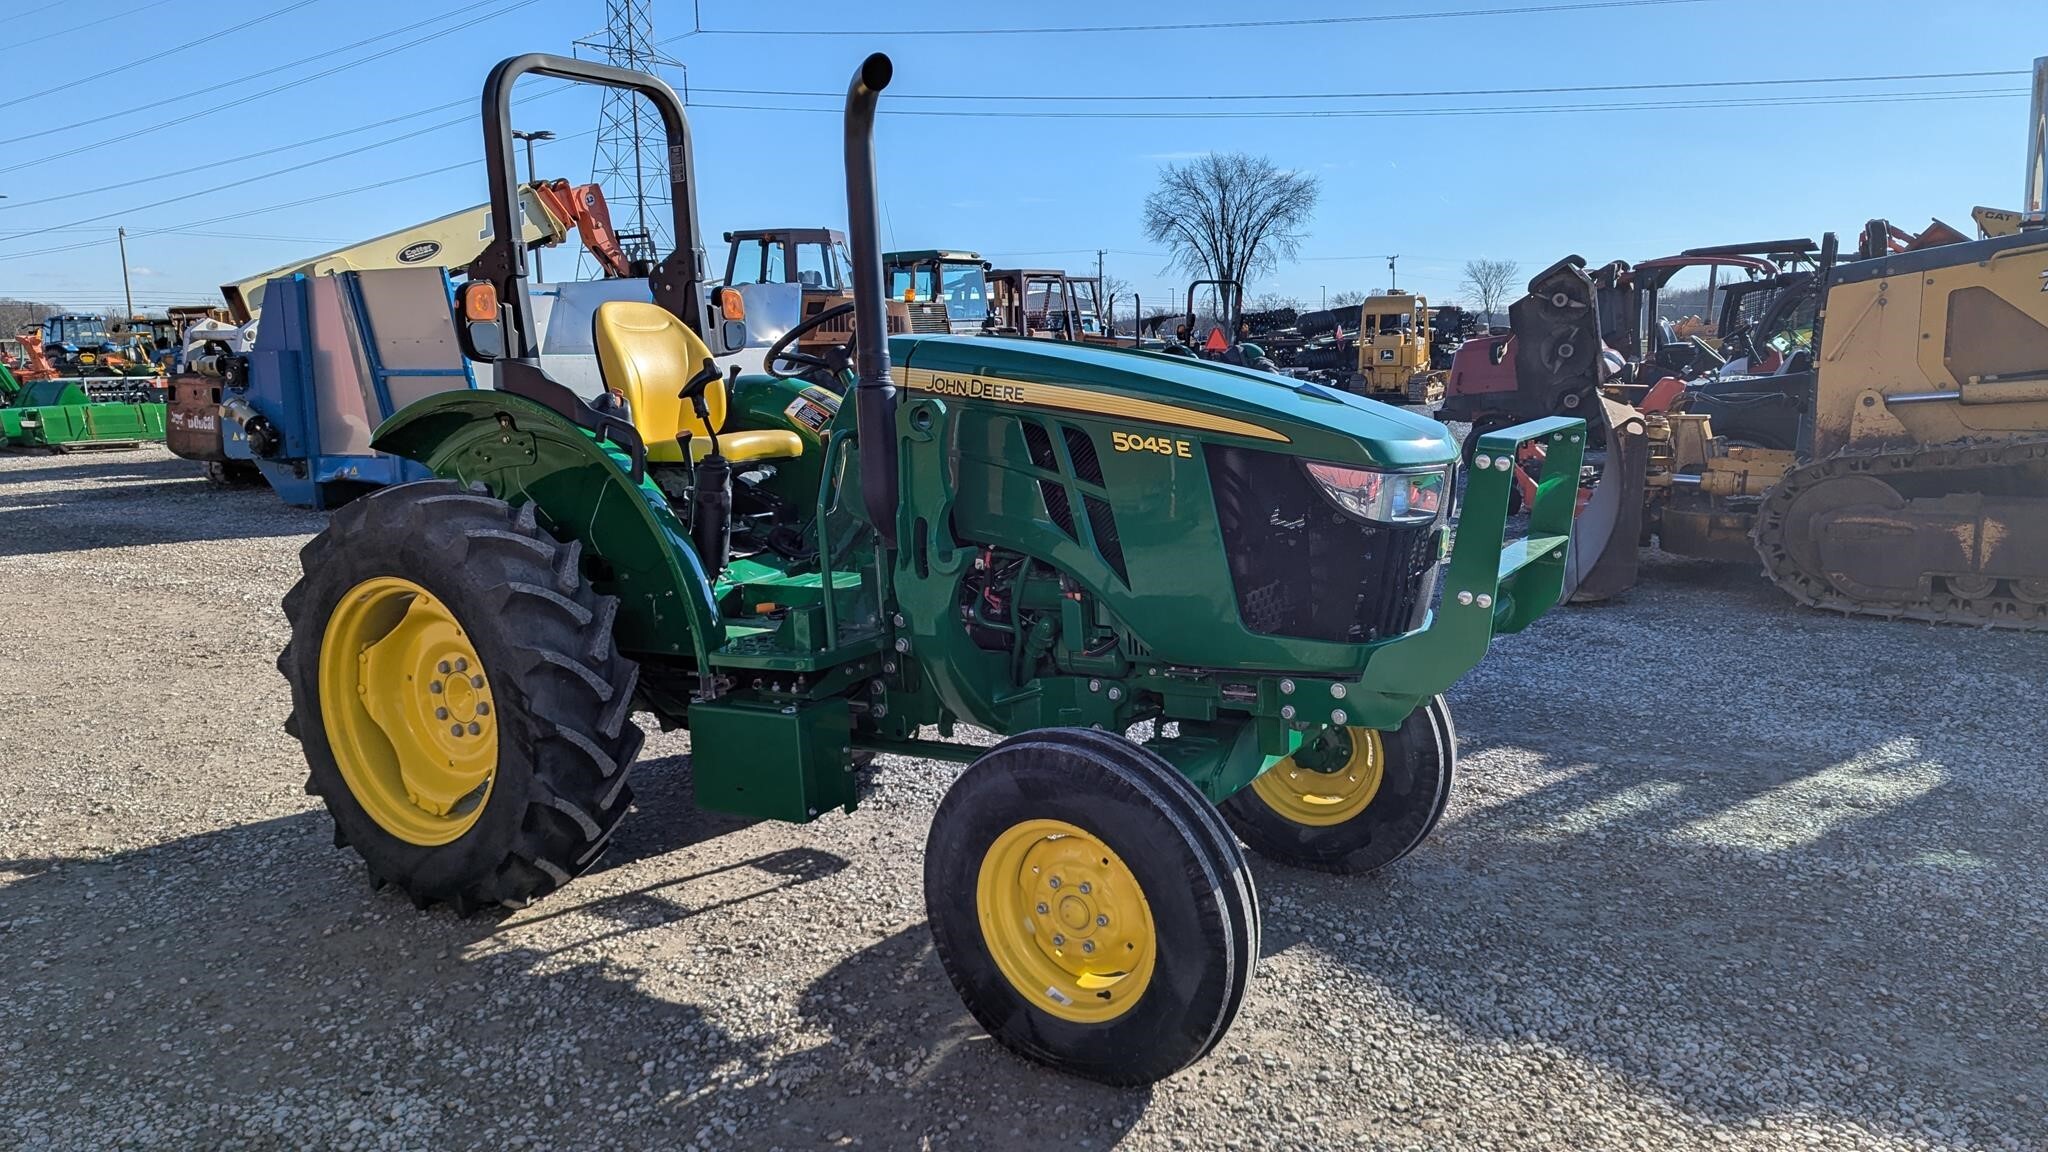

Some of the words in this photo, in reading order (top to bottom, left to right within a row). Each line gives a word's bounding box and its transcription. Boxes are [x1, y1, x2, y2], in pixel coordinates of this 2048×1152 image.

[1985, 211, 2012, 222] CAT
[926, 375, 967, 394] JOHN
[970, 379, 1025, 401] DEERE
[1112, 431, 1173, 456] 5045
[1176, 440, 1193, 459] E
